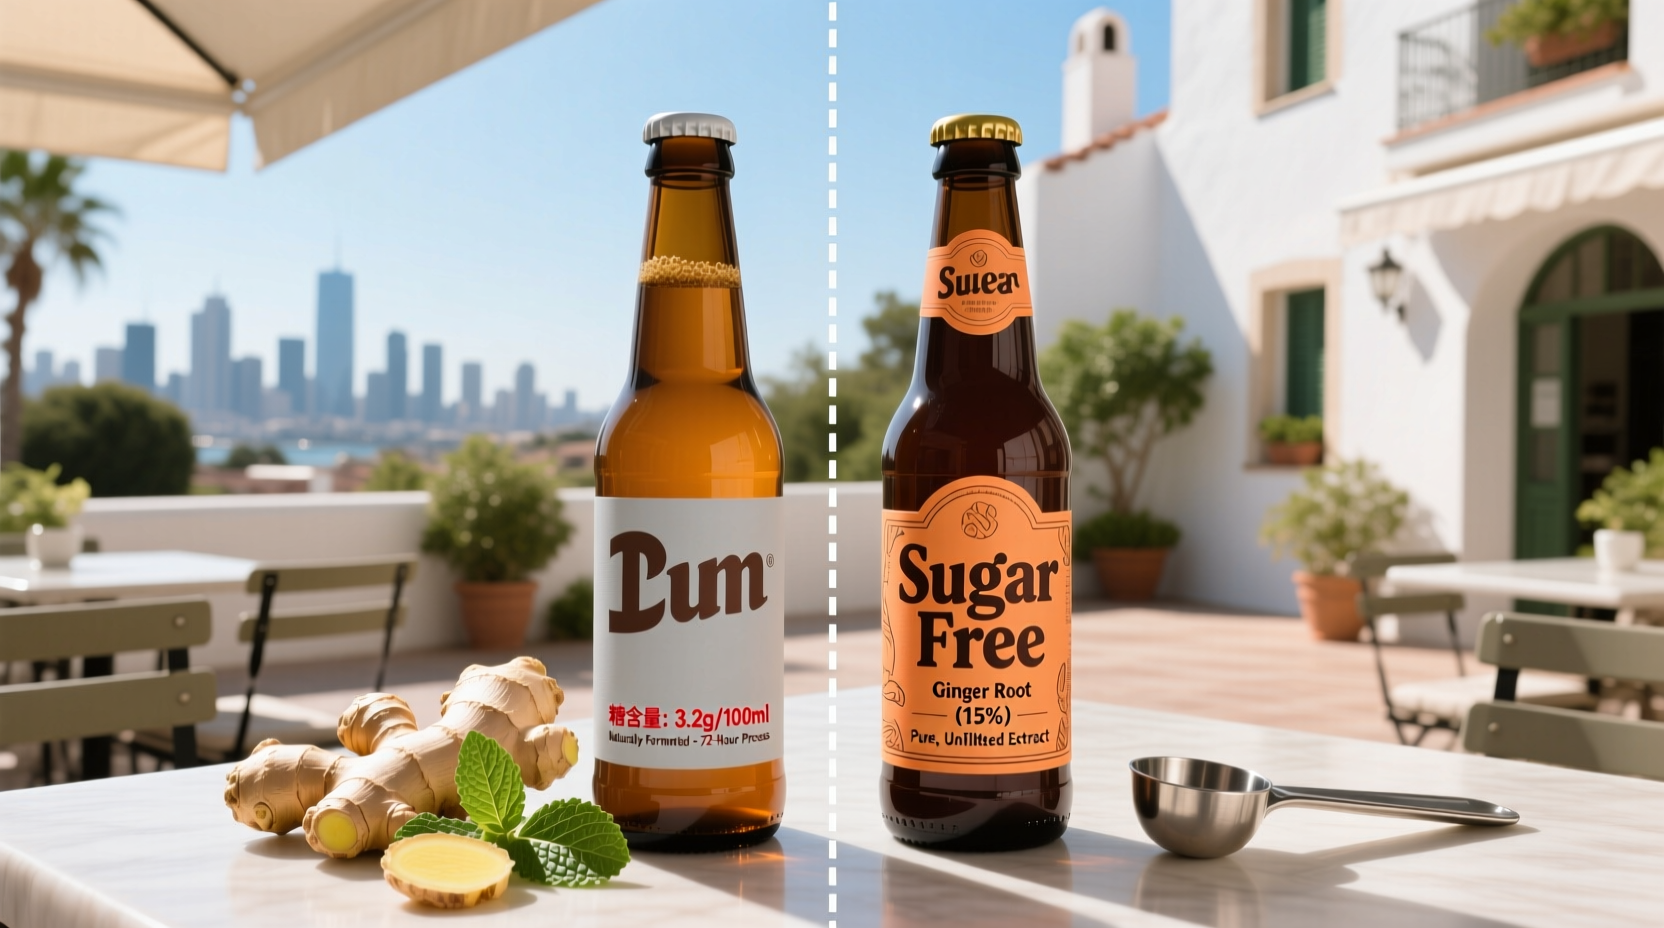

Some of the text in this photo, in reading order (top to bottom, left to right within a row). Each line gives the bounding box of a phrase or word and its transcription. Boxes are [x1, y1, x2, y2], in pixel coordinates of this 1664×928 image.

[898, 543, 1059, 621] Sugar
[917, 610, 1045, 669] Free
[932, 681, 1032, 703] Ginger Root
[675, 703, 769, 732] 3.2g/100ml
[955, 705, 1011, 727] (15%)
